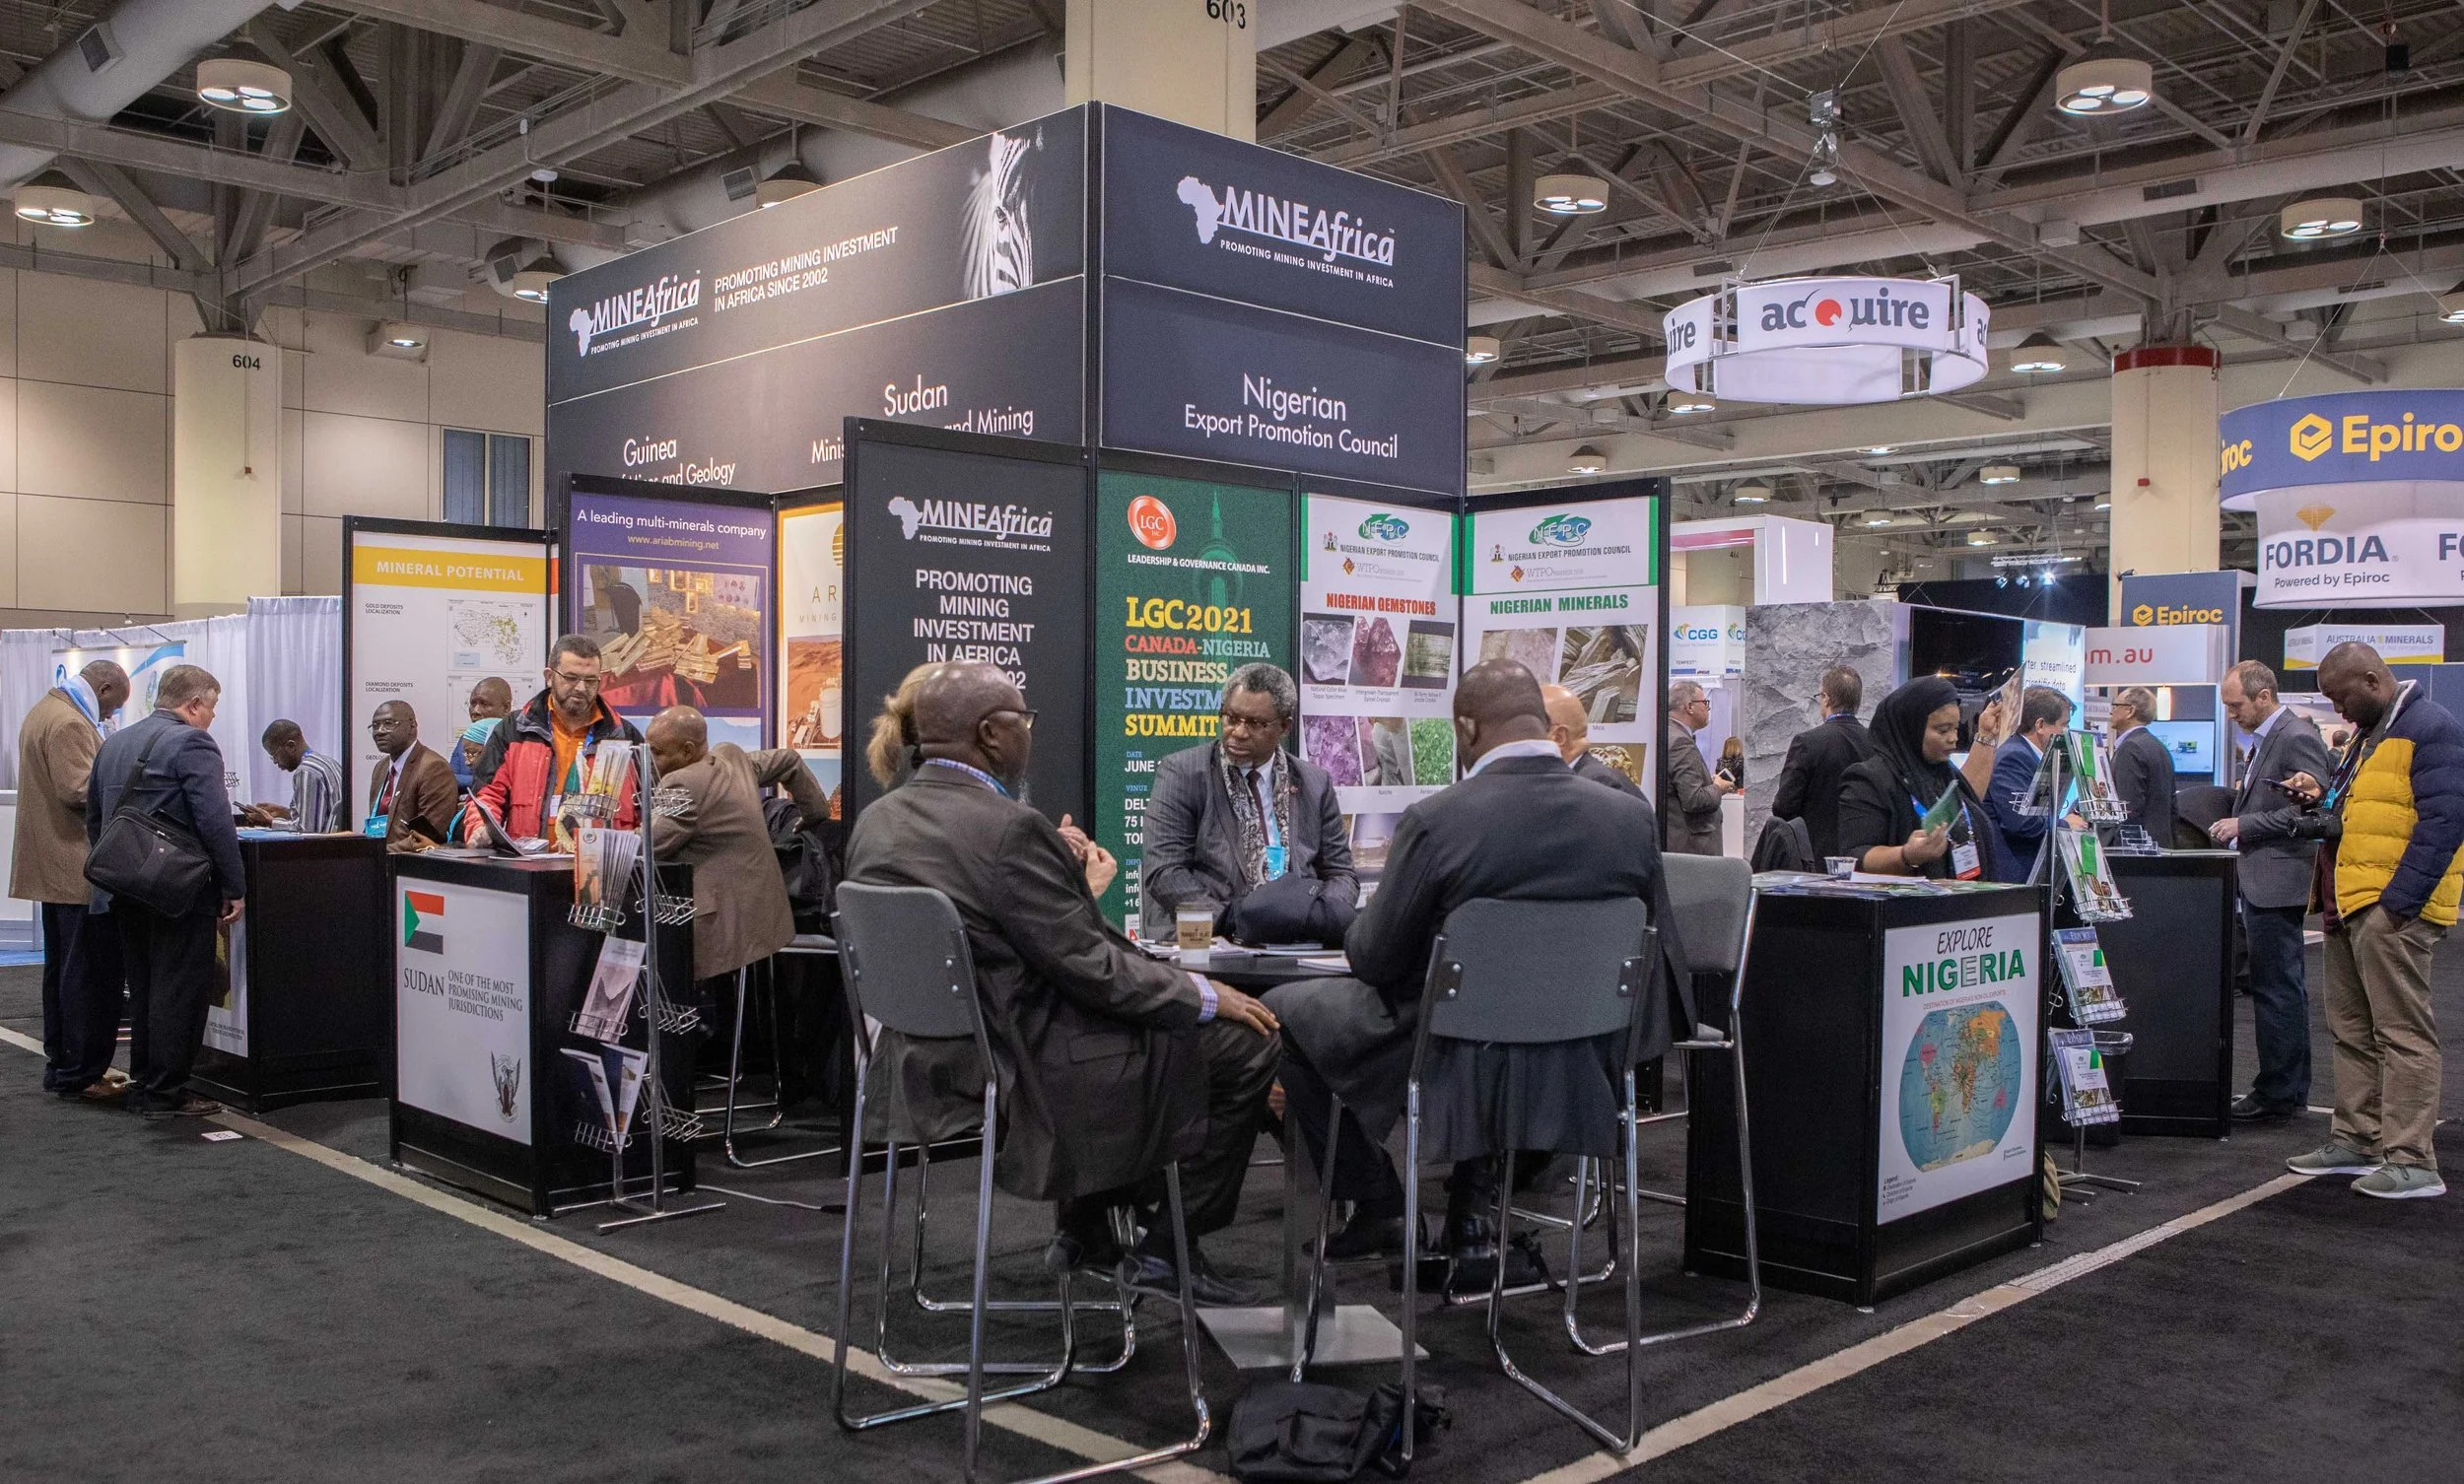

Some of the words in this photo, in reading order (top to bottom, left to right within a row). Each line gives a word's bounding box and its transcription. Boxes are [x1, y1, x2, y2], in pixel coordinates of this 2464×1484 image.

[1206, 0, 1246, 29] 603
[1223, 186, 1395, 266] MINEAfrica
[715, 261, 779, 294] PROMOTING
[781, 249, 821, 274] MINING
[823, 227, 898, 264] INVESTMENT
[1220, 239, 1271, 260] PROMOTING
[1273, 252, 1305, 267] MINING
[1307, 259, 1353, 279] INVESTMENT
[1355, 271, 1364, 282] IN
[1366, 273, 1394, 288] AFRICA
[715, 297, 725, 312] IN
[726, 284, 765, 308] AFRICA
[767, 275, 800, 300] SINCE
[801, 268, 828, 293] 2002
[592, 275, 701, 333] MINEAfrica
[591, 340, 619, 354] PROMOTING
[621, 335, 640, 347] MINING
[641, 326, 670, 340] INVESTMENT
[671, 323, 678, 332] IN
[679, 317, 699, 330] AFRICA
[233, 355, 261, 371] 604
[884, 374, 948, 417] Sudan
[1244, 372, 1346, 421] Nigerian
[978, 406, 1034, 436] Mining
[1185, 404, 1243, 438] Export
[1249, 414, 1333, 448] Promotion
[1338, 429, 1398, 458] Council
[623, 437, 677, 466] Guinea
[662, 463, 683, 485] and
[686, 457, 736, 486] Geology
[578, 509, 587, 521] A
[591, 509, 633, 528] leading
[637, 514, 715, 533] multi-minerals
[718, 523, 766, 540] company
[922, 499, 1053, 540] MINEAfrica
[1140, 515, 1164, 531] LGC
[1362, 522, 1407, 538] NEPC
[1534, 522, 1587, 539] NEPC
[628, 535, 719, 551] www.ariabmining.net
[920, 535, 957, 544] PROMOTING
[984, 541, 1019, 550] INVESTMENT
[1340, 544, 1365, 555] NIGERIAN
[1366, 548, 1386, 557] EXPORT
[1388, 550, 1418, 560] PROMOTION
[1419, 553, 1439, 562] COUNCIL
[1508, 553, 1537, 562] NIGERIAN
[1564, 548, 1602, 558] PROMOTION
[1603, 545, 1631, 554] COUNCIL
[2266, 535, 2389, 571] FORDIA
[376, 561, 443, 576] MINERAL
[446, 566, 524, 581] POTENTIAL
[1128, 554, 1172, 567] LEADERSHIP
[1180, 559, 1226, 571] GOVERNANCE
[1227, 563, 1256, 573] CANADA
[1257, 565, 1269, 573] INC.
[916, 569, 1033, 595] PROMOTING
[2275, 574, 2320, 588] Powered
[2324, 573, 2340, 587] by
[2344, 572, 2390, 586] Epiroc
[939, 595, 1009, 618] MINING
[1327, 593, 1375, 611] NIGERIAN
[1378, 597, 1436, 615] GEMSTONES
[1490, 598, 1551, 615] NIGERIAN
[1558, 594, 1628, 612] MINERALS
[2157, 605, 2223, 625] Epiroc
[914, 618, 1035, 642] INVESTMENT
[1688, 629, 1718, 641] CGG
[2327, 635, 2375, 643] AUSTRALIA
[2385, 636, 2433, 644] MINERALS
[927, 643, 946, 662] IN
[952, 645, 1021, 665] AFRICA
[1125, 635, 1270, 658] CANADA-NIGERIA
[1127, 659, 1228, 683] BUSINESS
[2040, 661, 2077, 674] streamlined
[1006, 671, 1026, 690] 02
[1126, 687, 1222, 709] INVESTM
[1126, 714, 1219, 736] SUMMIT
[1125, 760, 1155, 773] JUNE
[1125, 816, 1138, 828] 75
[1937, 926, 1993, 955] EXPLORE
[404, 968, 444, 997] SUDAN
[448, 970, 464, 984] ONE
[464, 974, 474, 986] OF
[474, 976, 491, 990] THE
[492, 979, 514, 995] MOST
[1902, 948, 2025, 997] NIGERIA
[448, 983, 490, 1004] PROMISING
[491, 993, 523, 1012] MINING
[448, 997, 504, 1022] JURISDICTIONS
